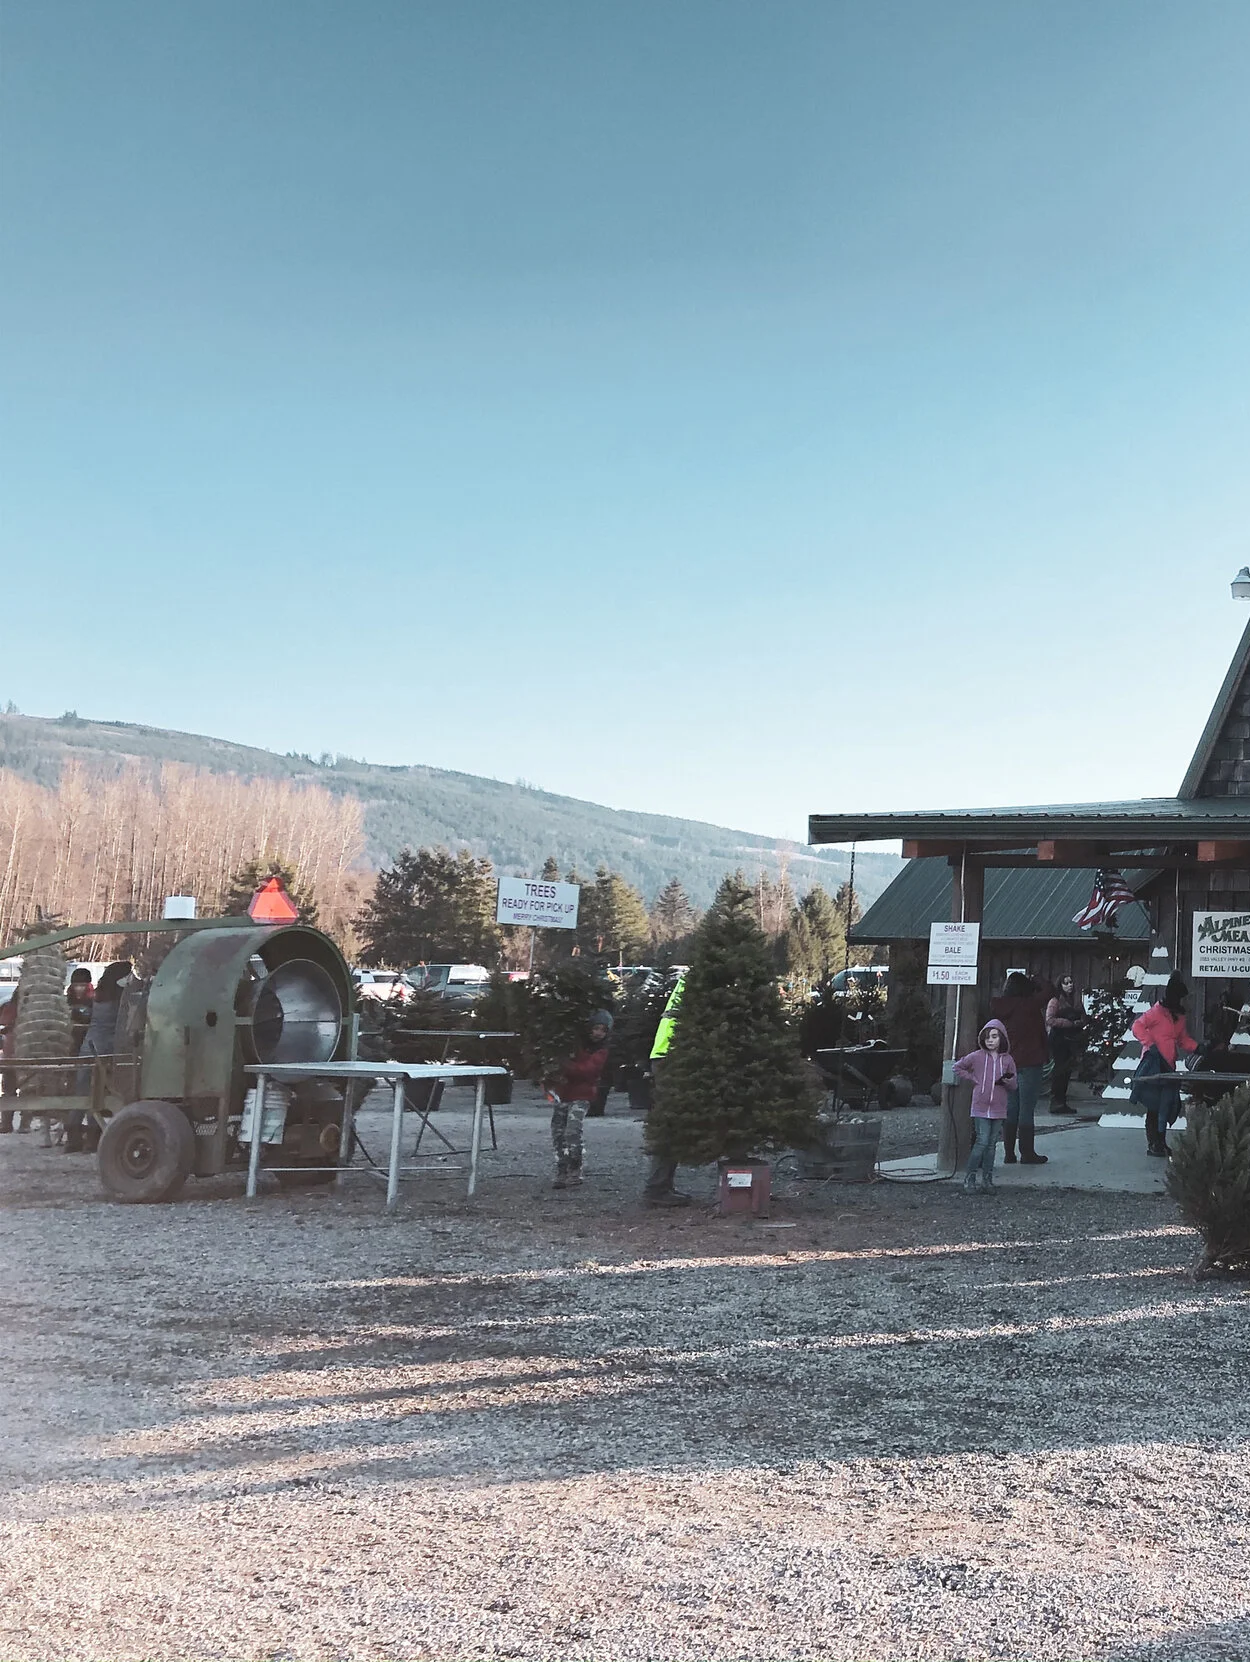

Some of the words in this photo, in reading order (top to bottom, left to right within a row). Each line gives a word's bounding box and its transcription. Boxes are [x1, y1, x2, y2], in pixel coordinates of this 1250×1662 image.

[525, 883, 557, 899] TREES
[502, 898, 528, 910] READY
[529, 900, 545, 912] FOR
[546, 901, 563, 913] PICK
[564, 904, 575, 914] UP
[944, 946, 962, 954] BALE
[1199, 965, 1226, 973] RETAIL
[932, 971, 950, 981] $1.50
